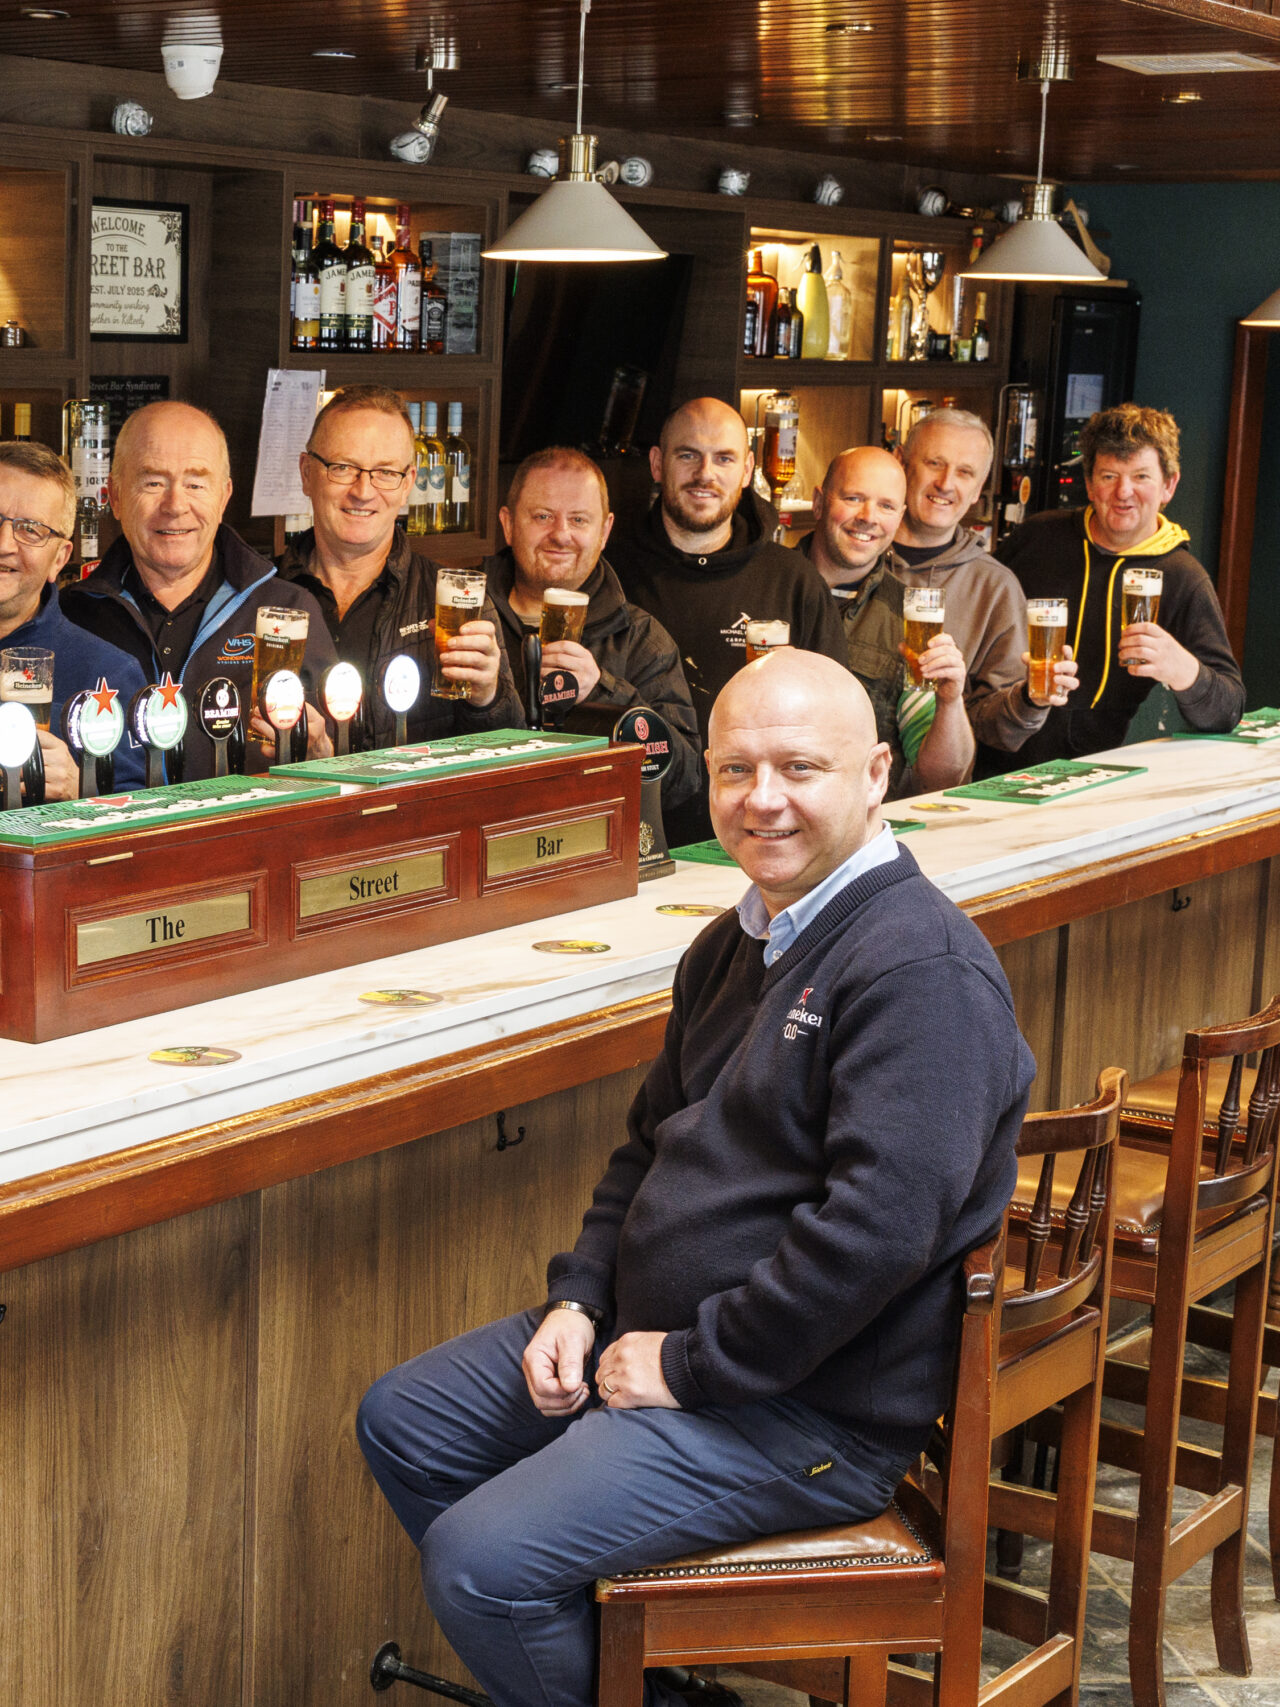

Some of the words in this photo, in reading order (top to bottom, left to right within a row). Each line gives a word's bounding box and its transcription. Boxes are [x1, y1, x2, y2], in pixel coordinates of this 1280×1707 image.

[91, 216, 146, 237] WELCOME
[106, 243, 115, 252] TO
[116, 244, 128, 253] THE
[91, 255, 129, 277] REET
[133, 256, 166, 280] BAR
[325, 268, 347, 280] JAME
[107, 285, 125, 296] JULY
[90, 300, 122, 312] ommunity
[543, 688, 576, 705] BEAMISH
[536, 836, 564, 859] Bar
[349, 870, 400, 901] Street
[145, 915, 186, 944] The
